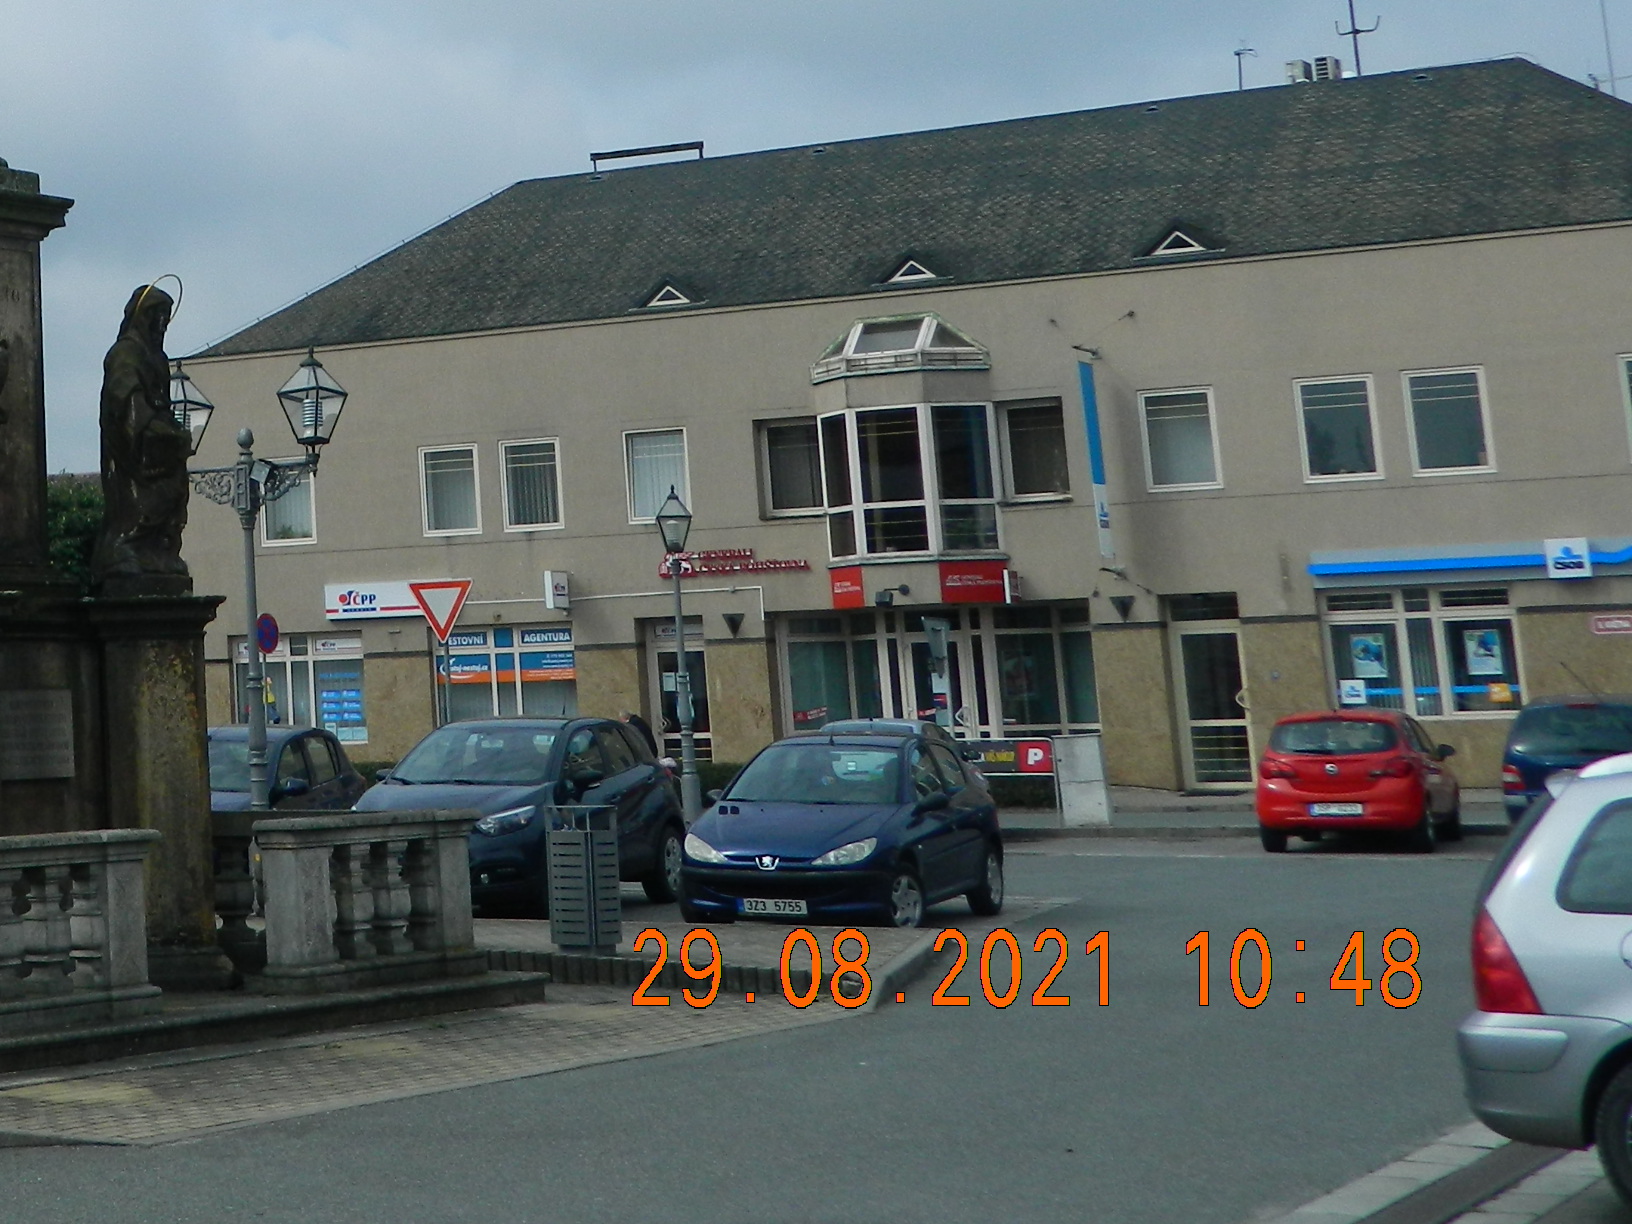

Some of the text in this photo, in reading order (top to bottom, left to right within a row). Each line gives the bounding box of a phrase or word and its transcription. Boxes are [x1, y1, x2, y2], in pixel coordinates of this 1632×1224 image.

[352, 591, 377, 606] ČPP
[448, 632, 571, 646] ESTOVNÍ AGENTURA
[1027, 748, 1044, 765] P
[746, 899, 802, 913] 3Z3 5755
